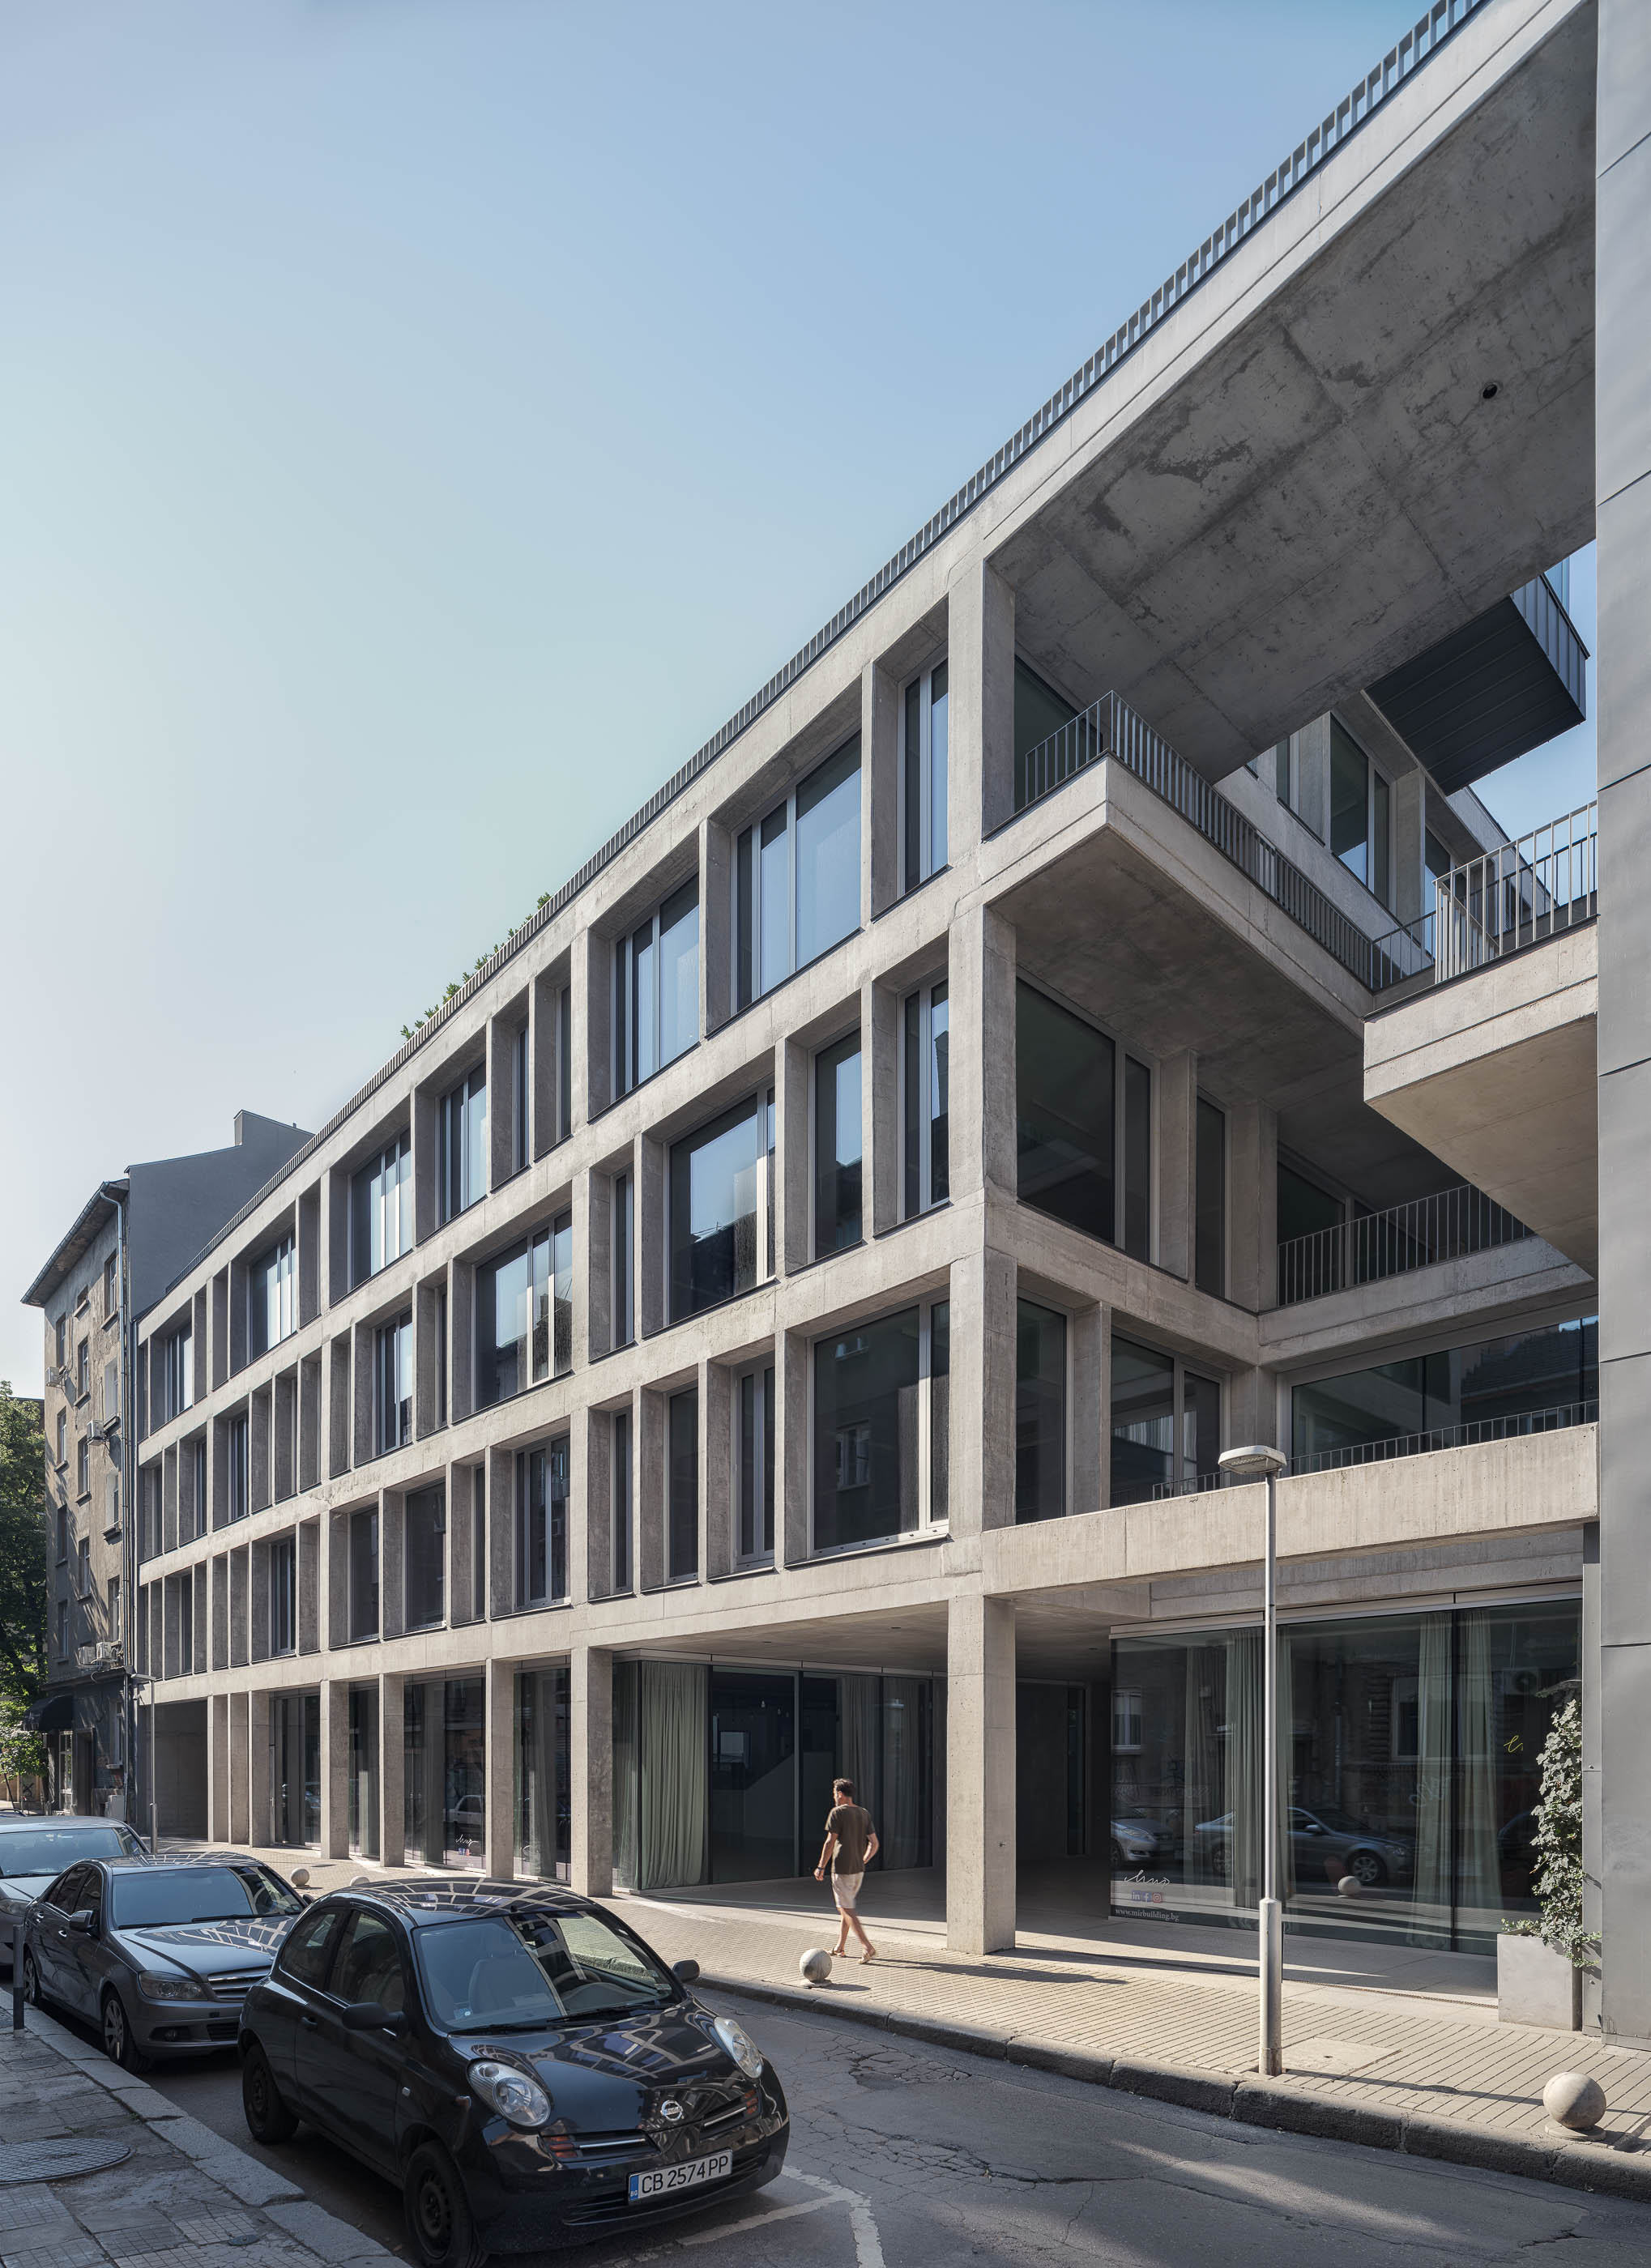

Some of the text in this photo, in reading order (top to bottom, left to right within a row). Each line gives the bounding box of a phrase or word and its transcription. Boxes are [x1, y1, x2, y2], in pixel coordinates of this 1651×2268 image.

[1115, 1908, 1180, 1922] www.mirbuilding.bg
[667, 2161, 705, 2189] 2574
[629, 2189, 638, 2198] BG
